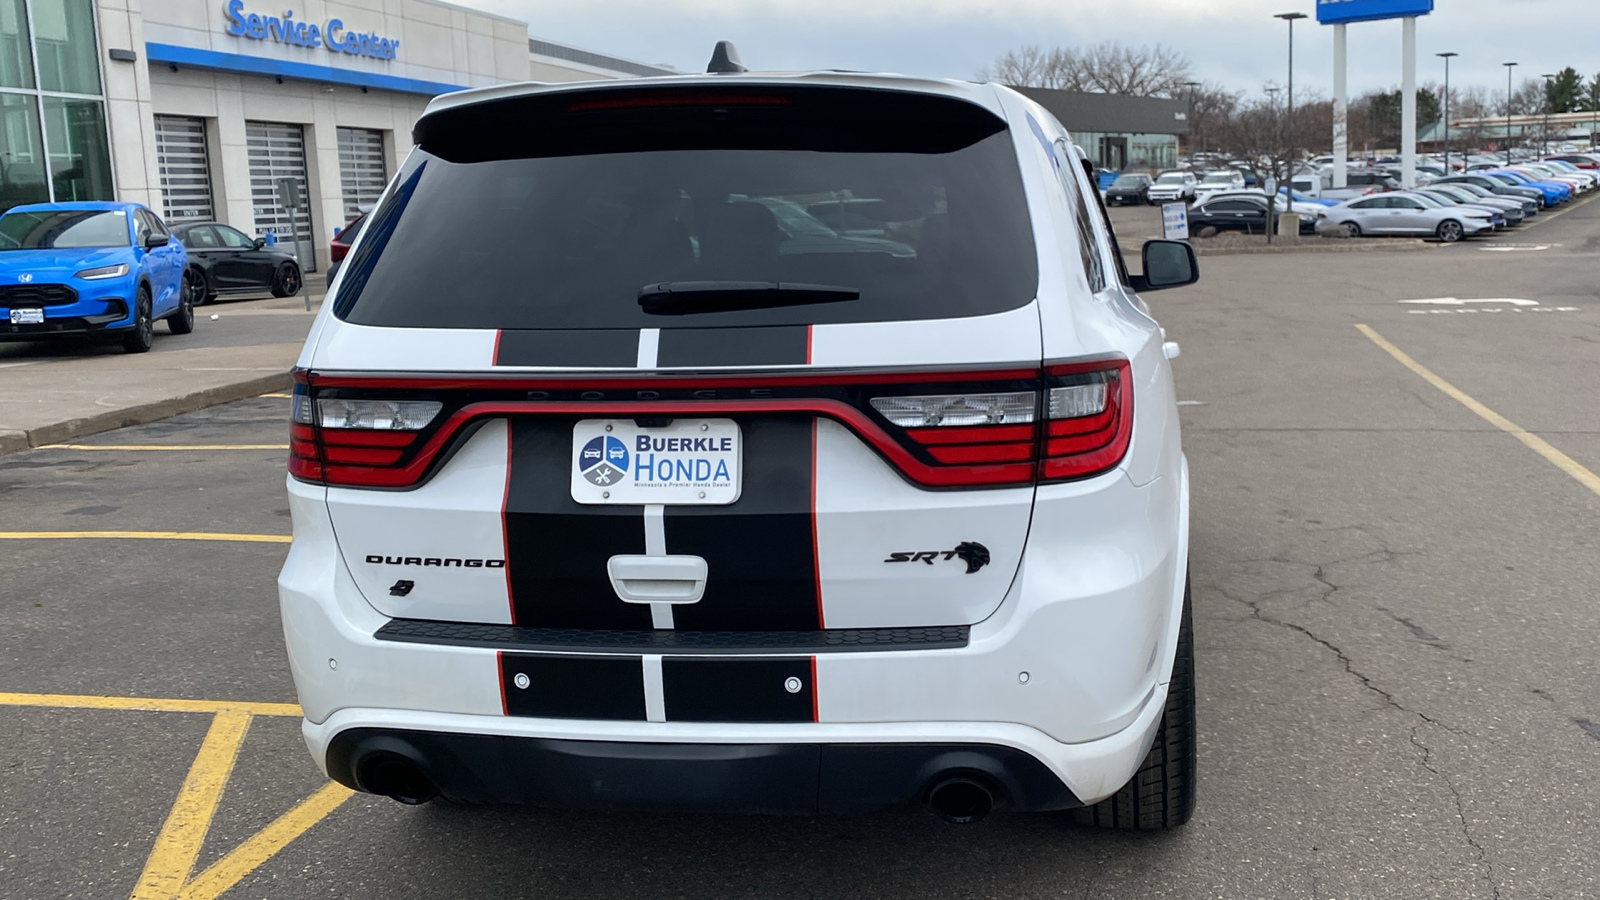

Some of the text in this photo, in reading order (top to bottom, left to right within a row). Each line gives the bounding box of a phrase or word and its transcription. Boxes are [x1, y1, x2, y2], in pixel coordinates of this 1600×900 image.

[223, 0, 400, 60] Service Center
[527, 389, 772, 400] DODGE
[636, 435, 732, 452] BUERKLE
[634, 453, 731, 481] HONDA
[365, 555, 506, 568] DURANGO
[883, 550, 961, 566] SRT
